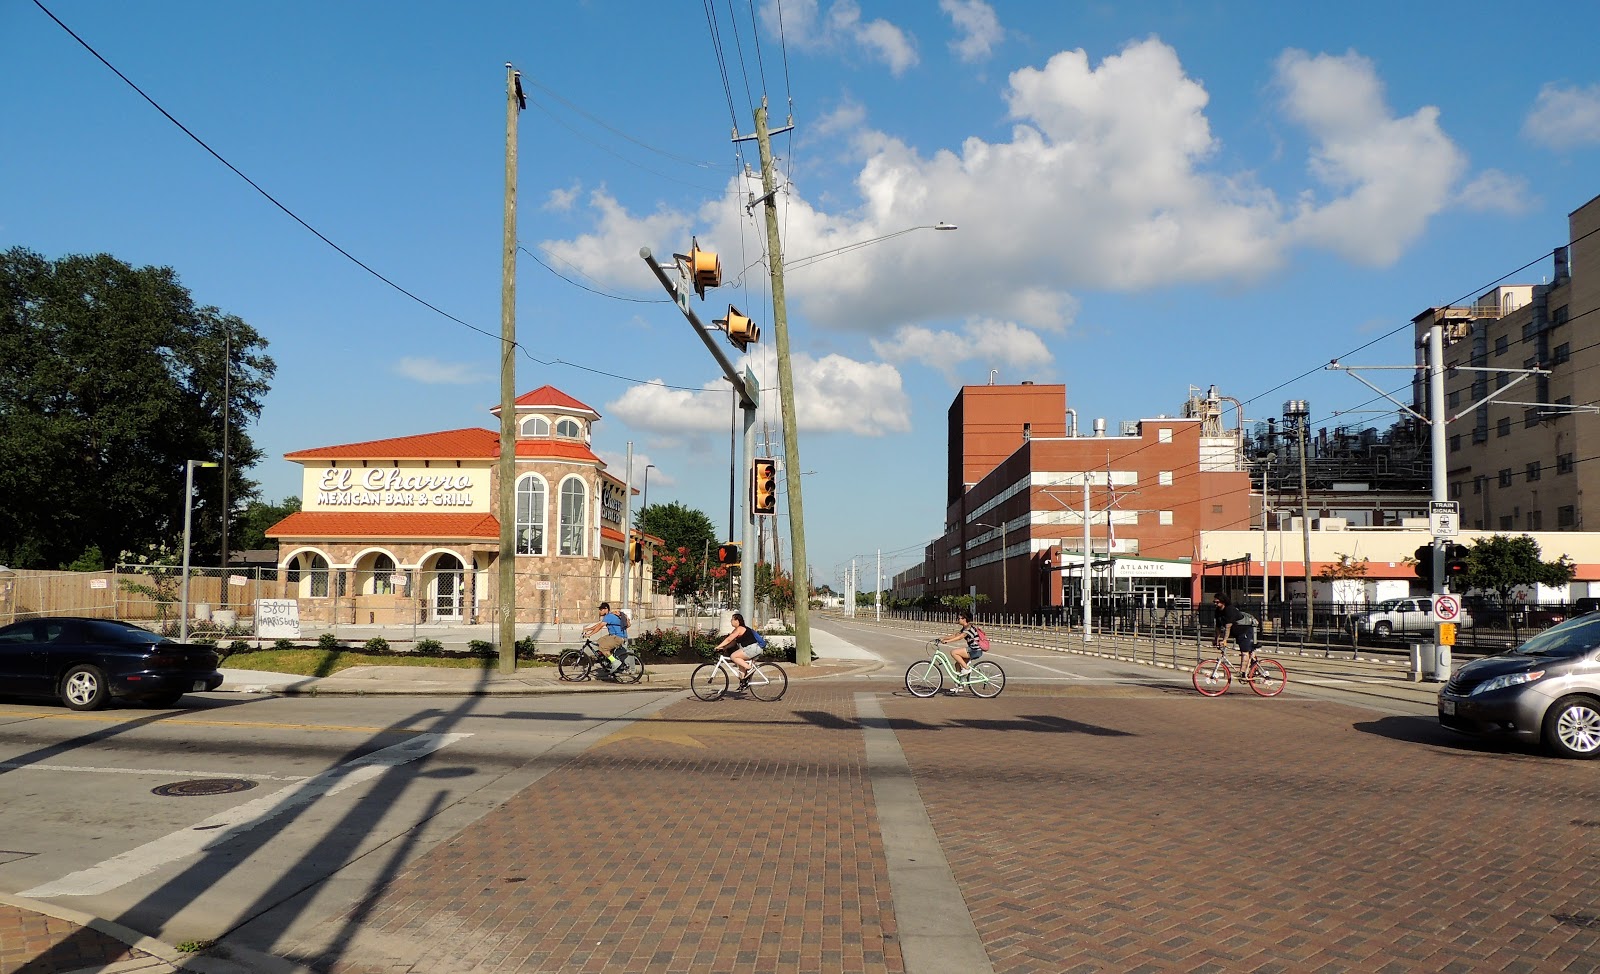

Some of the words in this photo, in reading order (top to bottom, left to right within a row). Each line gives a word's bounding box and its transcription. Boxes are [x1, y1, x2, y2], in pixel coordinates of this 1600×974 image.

[319, 468, 352, 491] El
[362, 468, 473, 491] Charro
[317, 492, 381, 506] MEXICAN
[385, 492, 414, 506] BAR
[418, 493, 428, 506] &
[432, 492, 473, 506] GRILL
[263, 601, 290, 614] 3801
